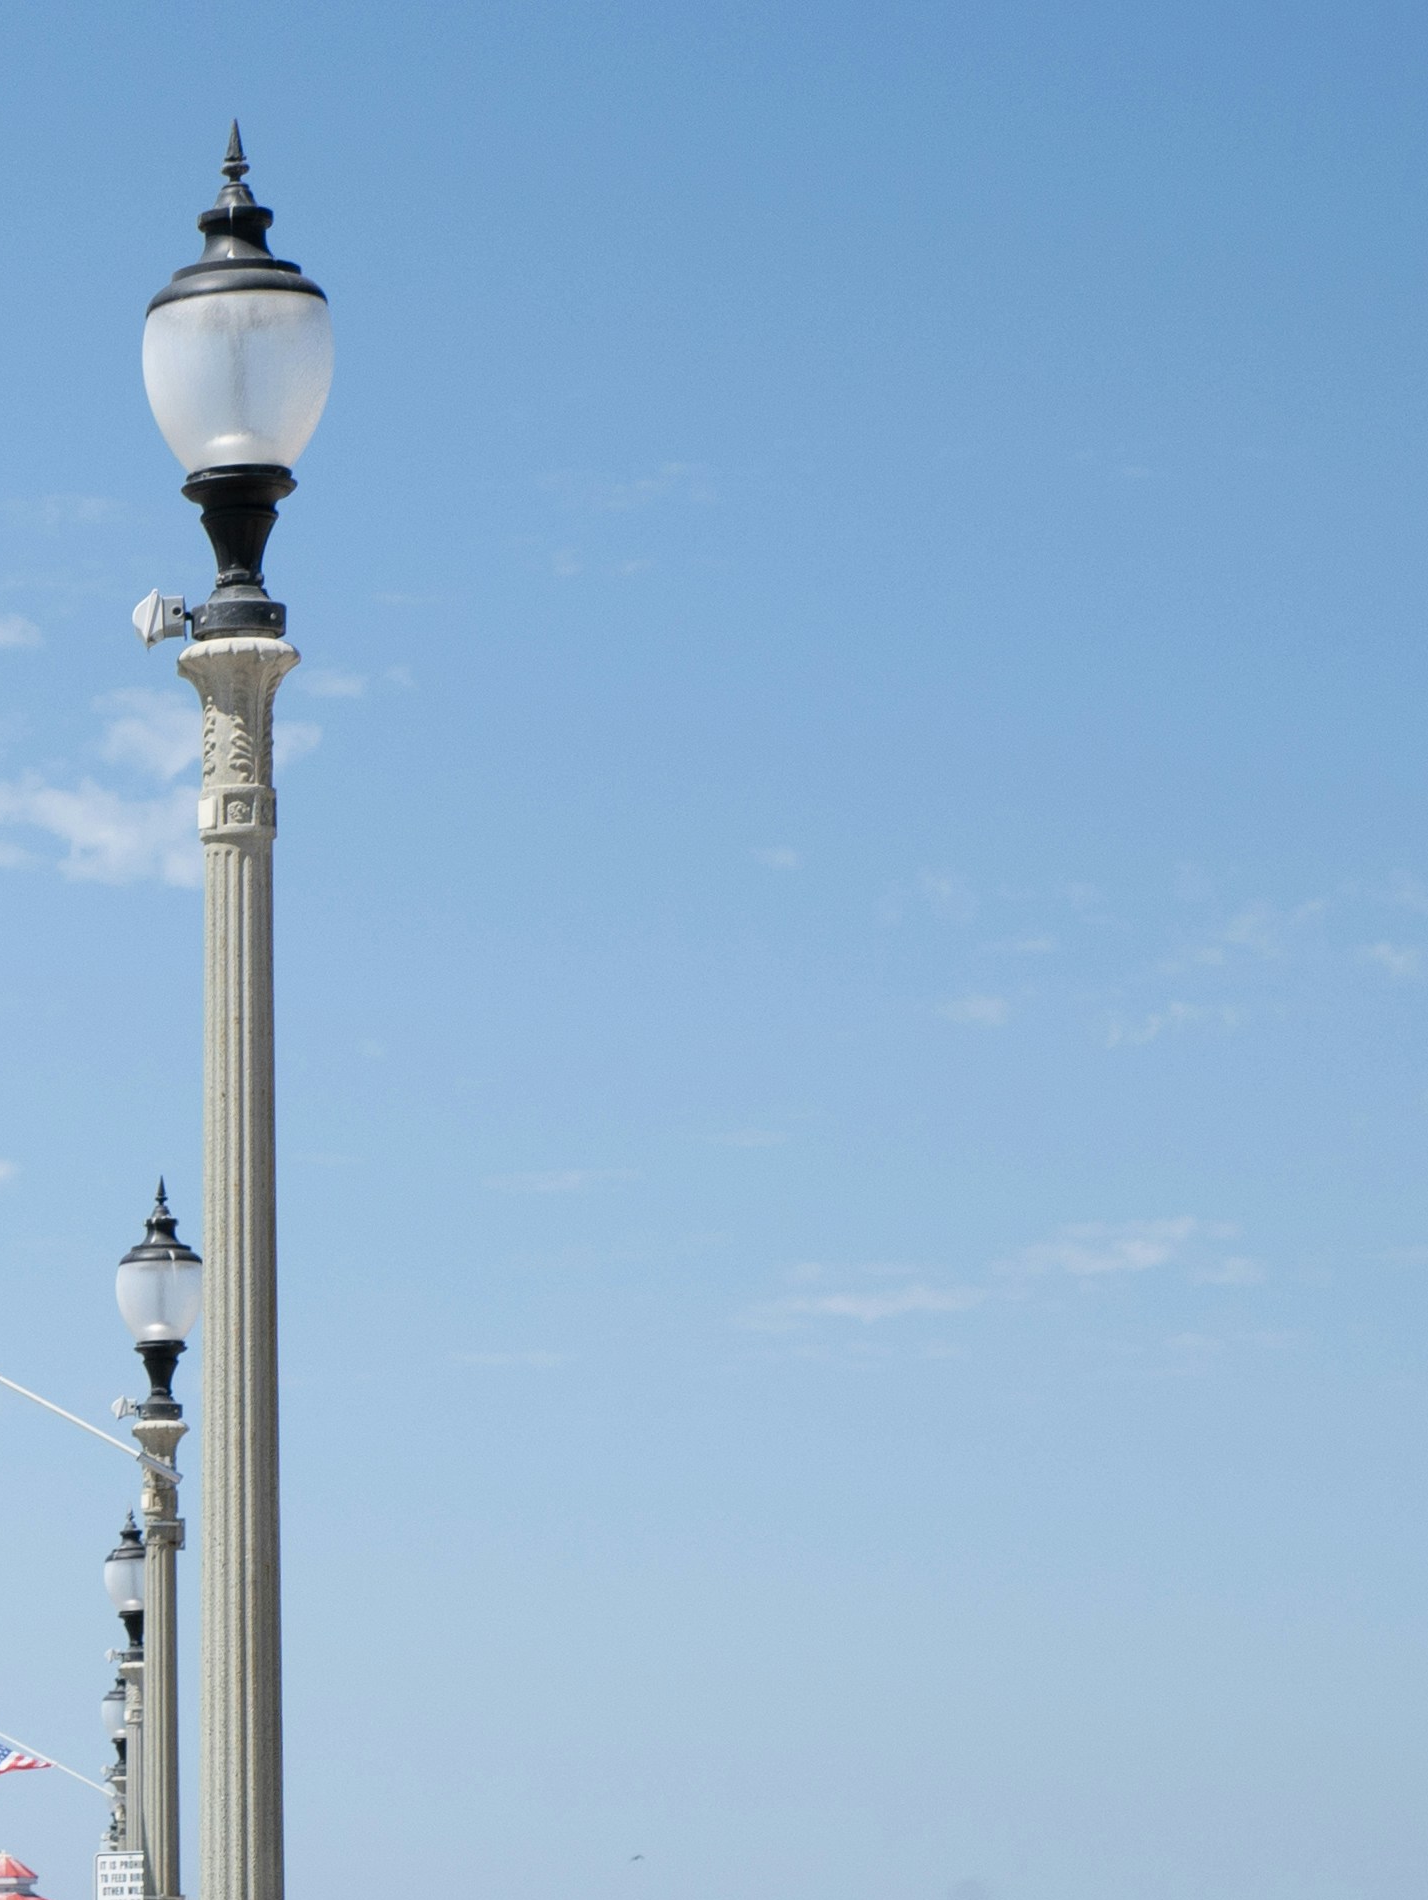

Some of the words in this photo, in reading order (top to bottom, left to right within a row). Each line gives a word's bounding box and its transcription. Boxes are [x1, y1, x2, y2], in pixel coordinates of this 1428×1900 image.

[100, 1861, 107, 1870] IT
[100, 1873, 108, 1883] TO
[111, 1873, 127, 1882] FEED
[103, 1886, 124, 1896] OTHER
